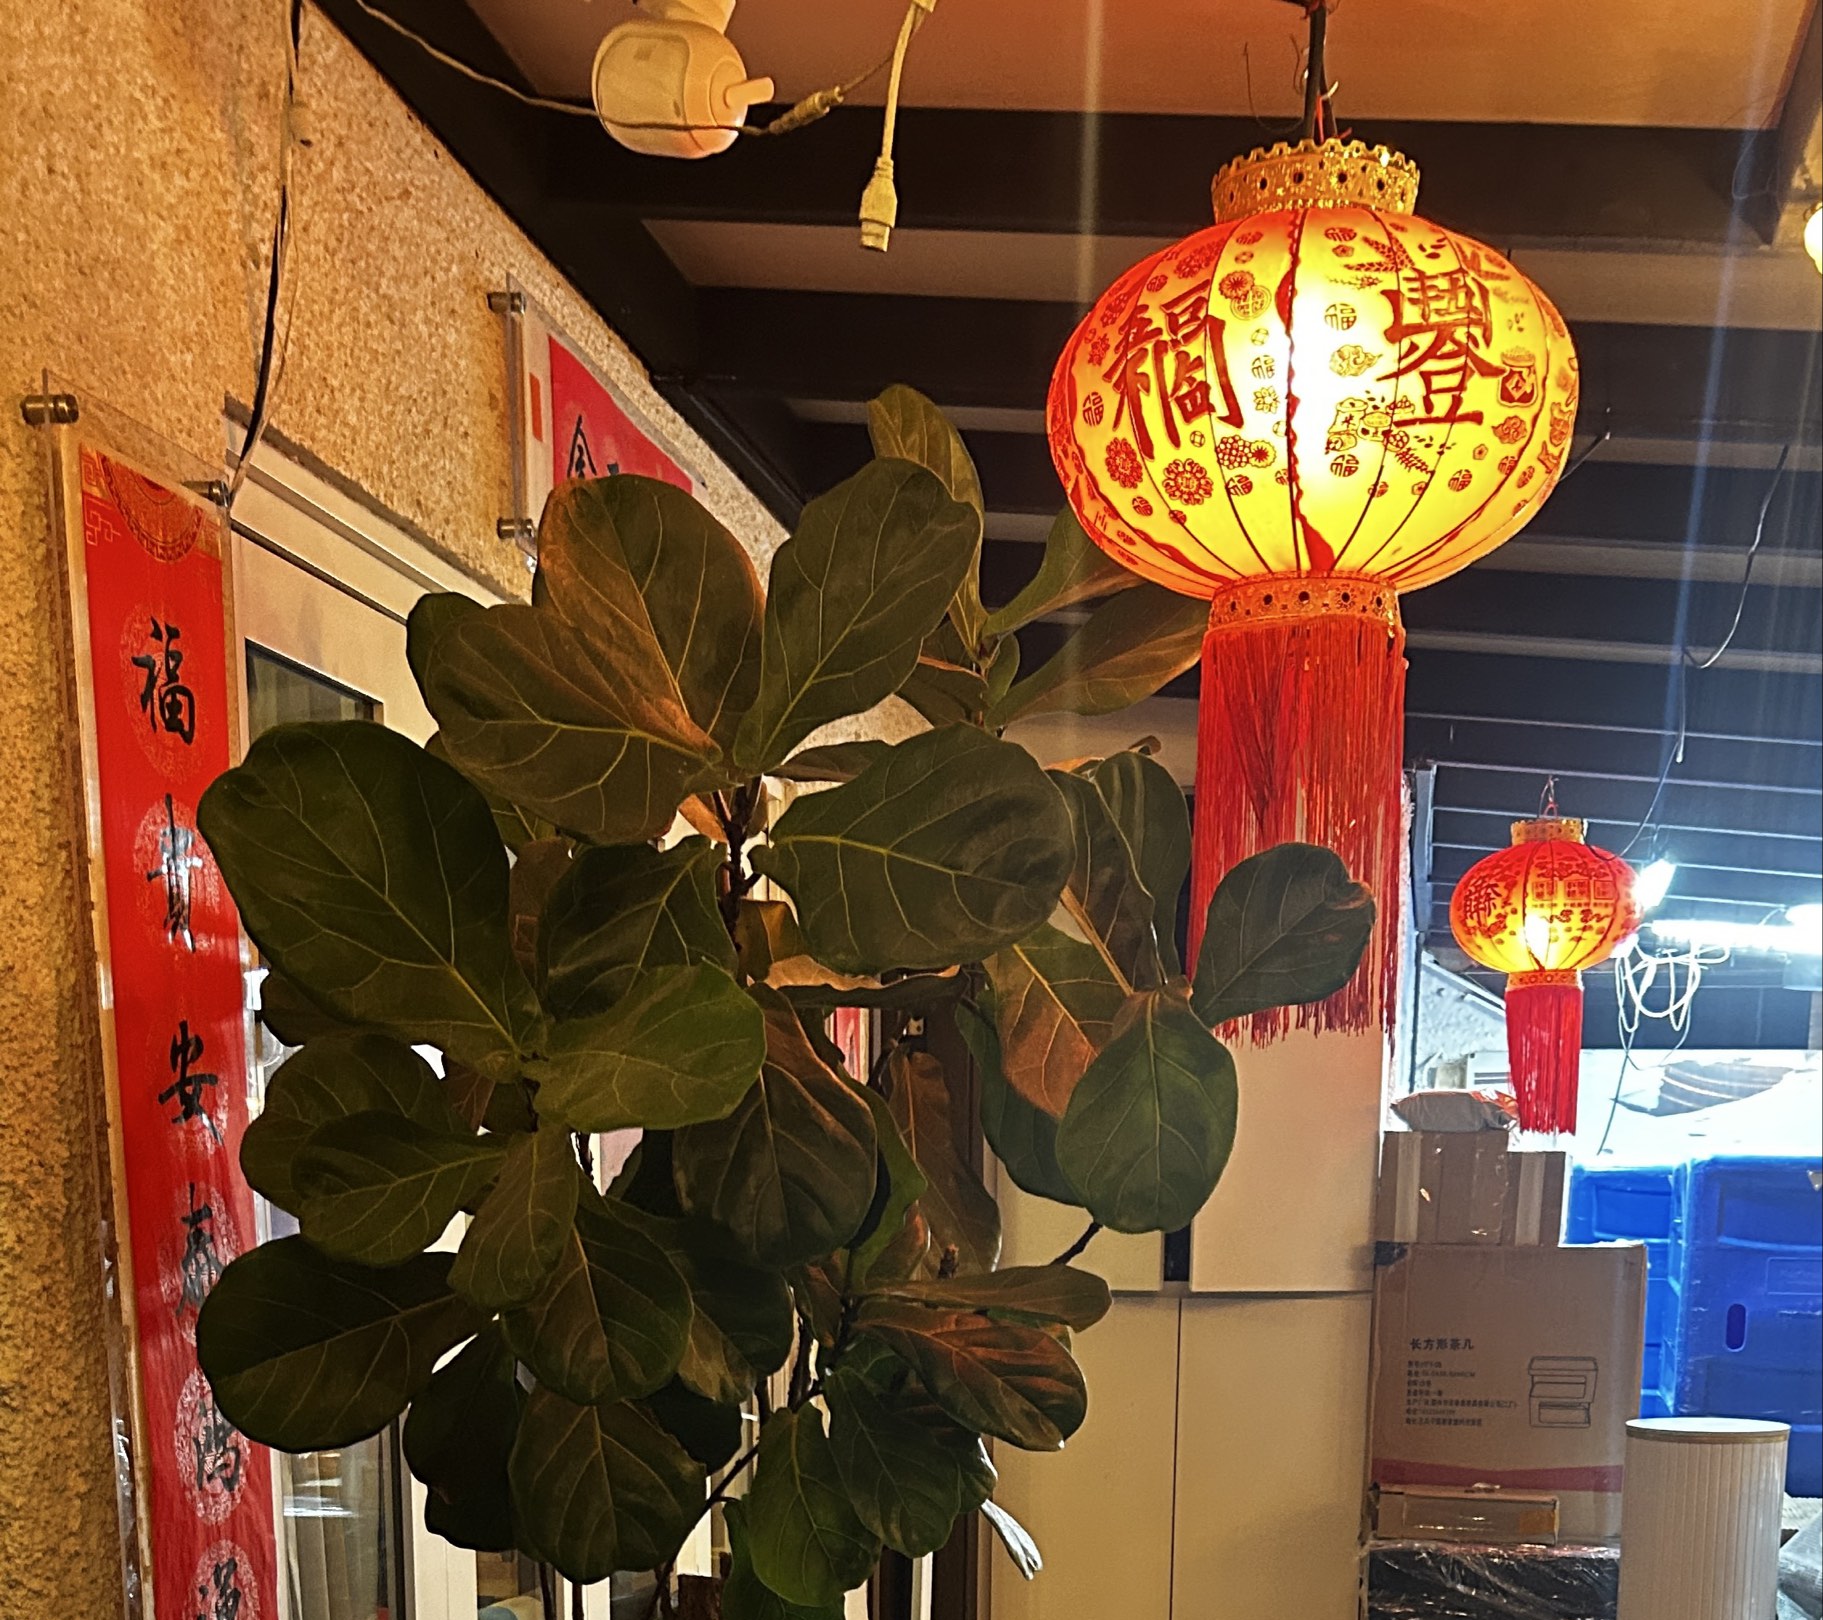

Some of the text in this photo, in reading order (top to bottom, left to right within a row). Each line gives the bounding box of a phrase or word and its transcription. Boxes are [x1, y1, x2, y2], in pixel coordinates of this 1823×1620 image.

[1409, 1337, 1475, 1351] 长方形茶几
